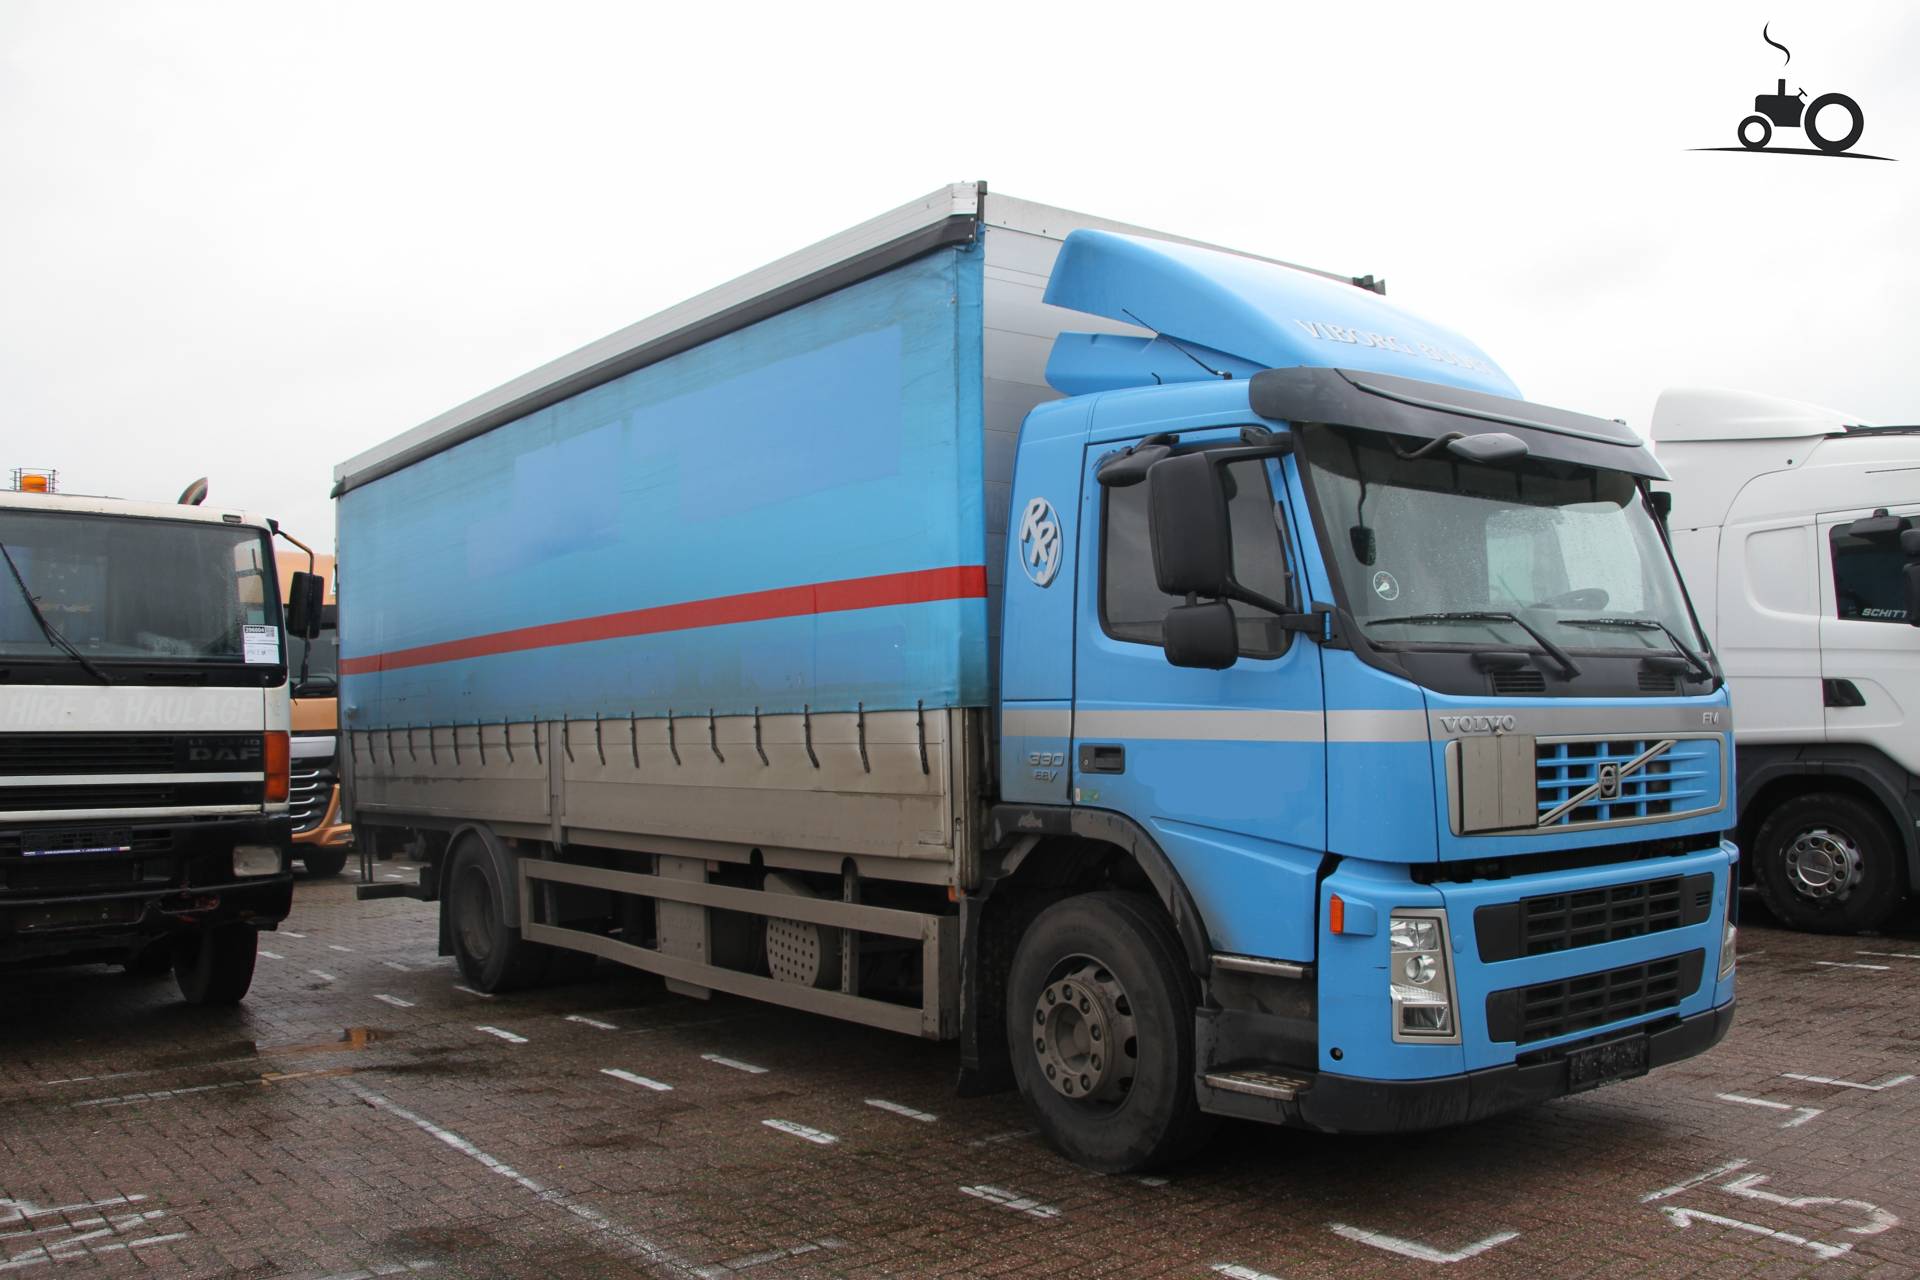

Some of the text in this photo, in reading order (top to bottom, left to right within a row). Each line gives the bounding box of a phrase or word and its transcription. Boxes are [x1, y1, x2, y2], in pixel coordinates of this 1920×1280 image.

[125, 694, 258, 725] HAULAGE
[1440, 714, 1516, 735] VOLVO
[189, 747, 261, 761] DAF
